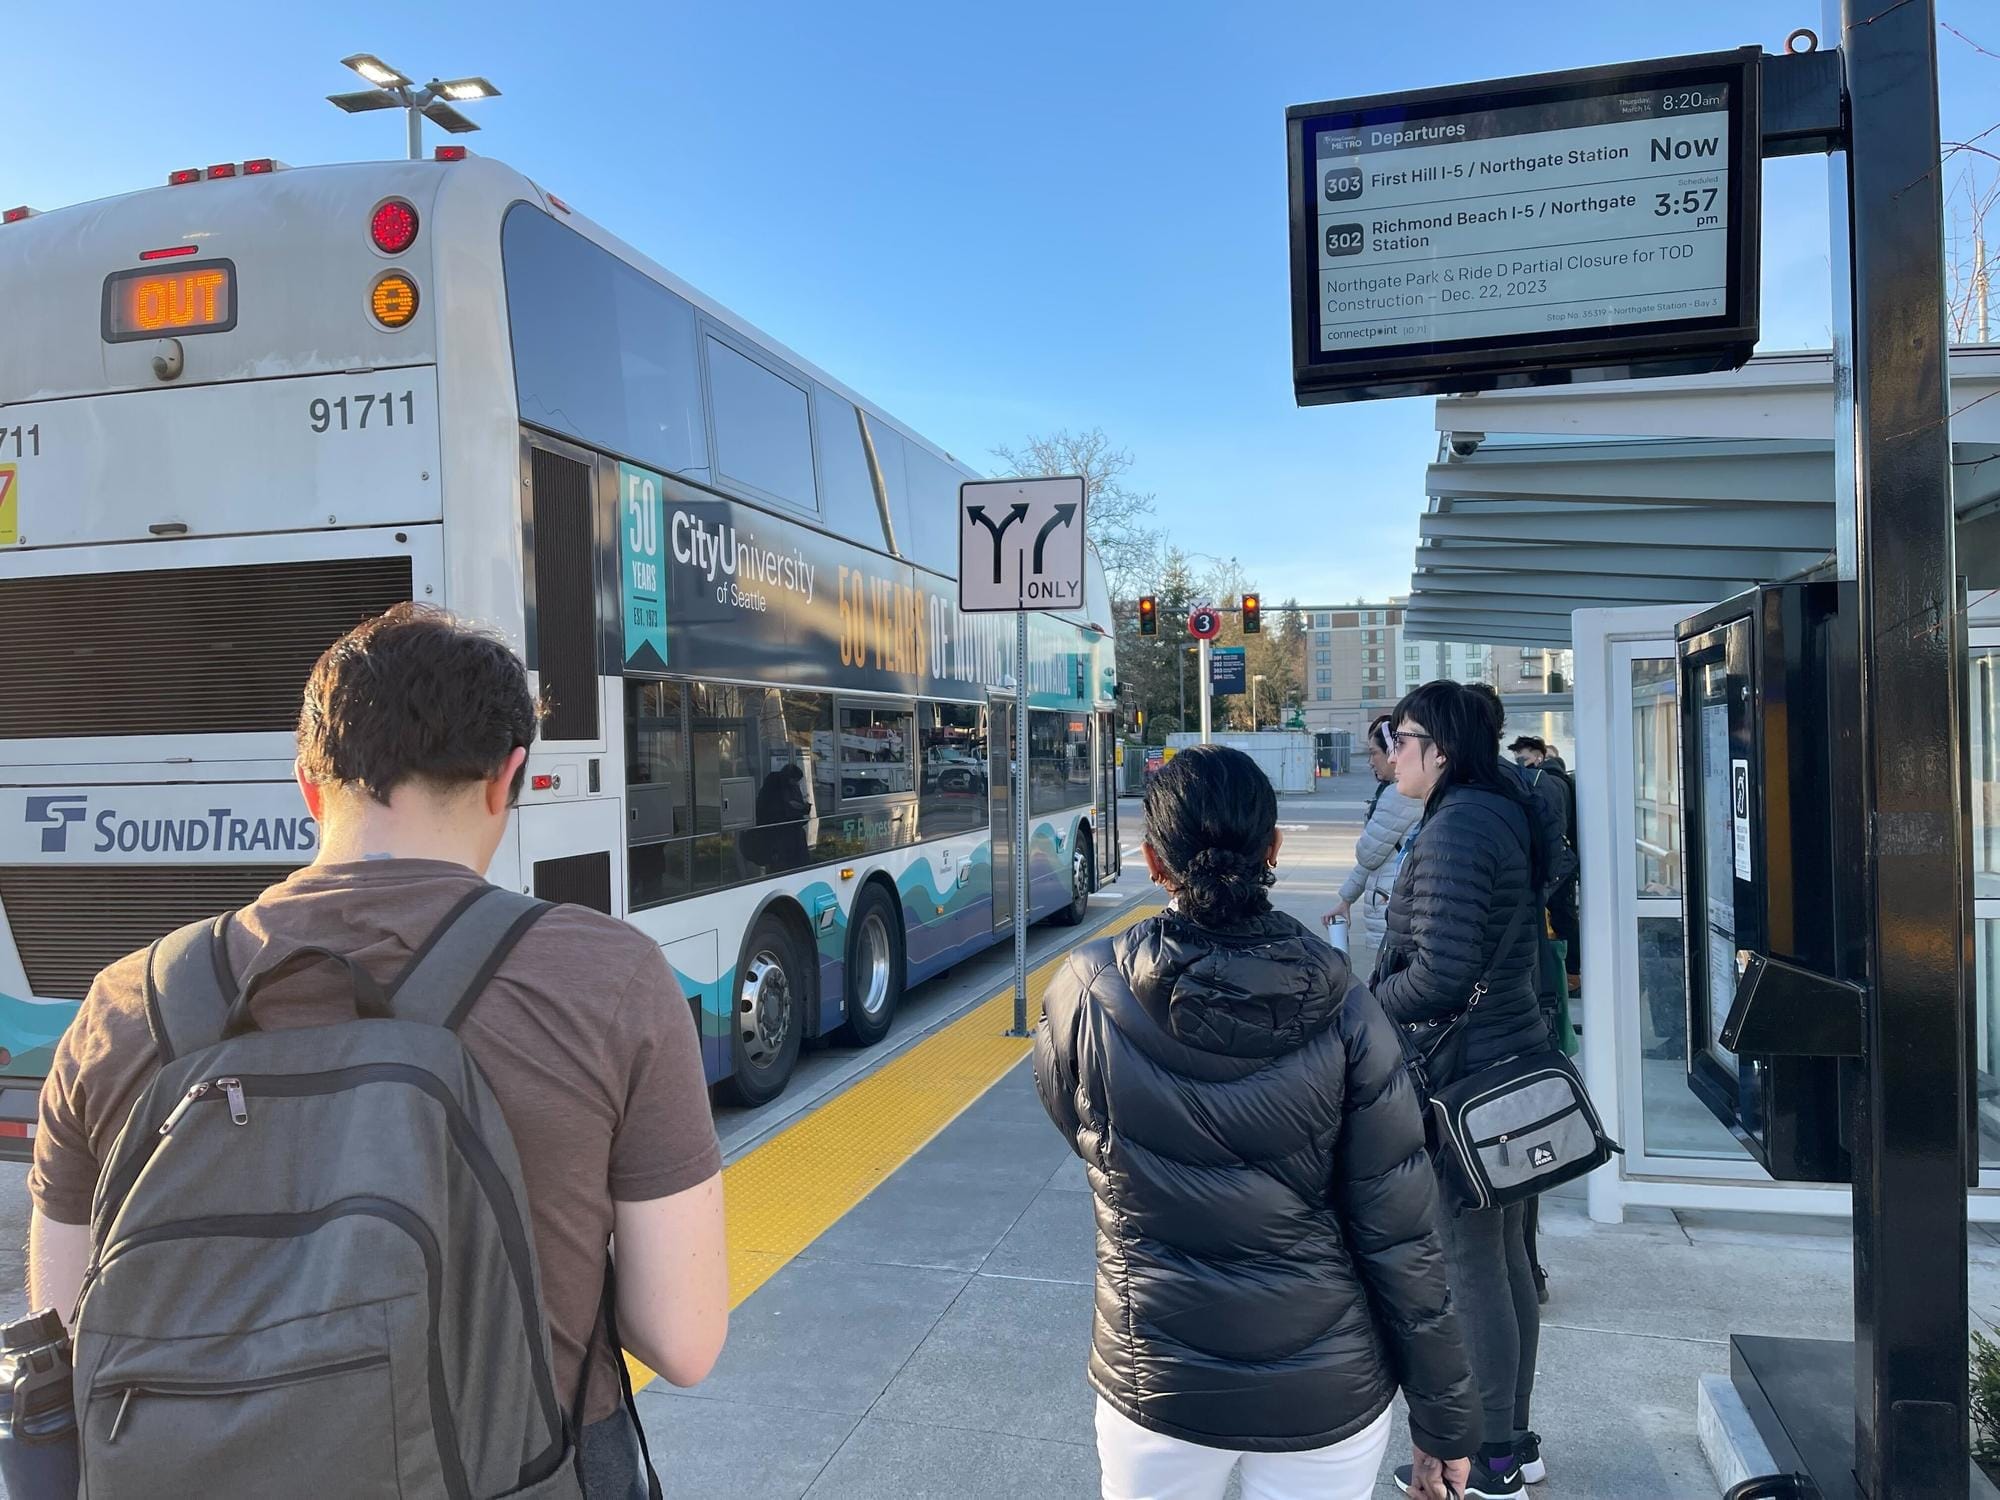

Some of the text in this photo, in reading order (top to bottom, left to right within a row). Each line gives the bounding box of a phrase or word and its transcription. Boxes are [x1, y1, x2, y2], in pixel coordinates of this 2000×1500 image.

[1622, 105, 1643, 114] March
[1663, 91, 1720, 111] 8:20am
[1331, 139, 1363, 151] METRO
[1371, 123, 1466, 147] Departures
[1651, 136, 1719, 162] Now
[1371, 146, 1629, 188] First Hill I-5 / Northgate Station
[1327, 175, 1361, 194] 303
[1678, 176, 1719, 187] Scheduled
[1372, 194, 1636, 235] Richmond Beach I-5 / Northgate
[1654, 188, 1718, 217] 3:57
[1697, 214, 1718, 227] pm
[1328, 231, 1362, 249] 302
[1372, 235, 1430, 252] Station
[1327, 244, 1694, 294] Northgate Park & Ride D Partial Closure for TOD
[139, 273, 224, 328] OUT
[1327, 293, 1424, 313] Construction
[1441, 288, 1475, 302] Dec.
[1479, 284, 1502, 299] 22,
[1507, 279, 1547, 296] 2023
[1547, 312, 1566, 322] Stop
[1582, 307, 1606, 319] 35319
[1614, 303, 1655, 316] Northgate
[1656, 300, 1687, 311] Station
[1694, 298, 1710, 308] Bay
[1711, 298, 1718, 306] 3
[309, 390, 414, 433] 91711
[629, 474, 657, 556] 50
[671, 510, 815, 604] CityUniversity
[632, 561, 657, 592] YEARS
[1028, 580, 1079, 599] ONLY
[716, 581, 767, 613] of Seattle
[838, 565, 865, 668] 50
[871, 576, 925, 678] YEARS
[930, 594, 949, 680] OF
[1198, 615, 1210, 632] 3
[94, 808, 320, 853] SOUNDTRANS
